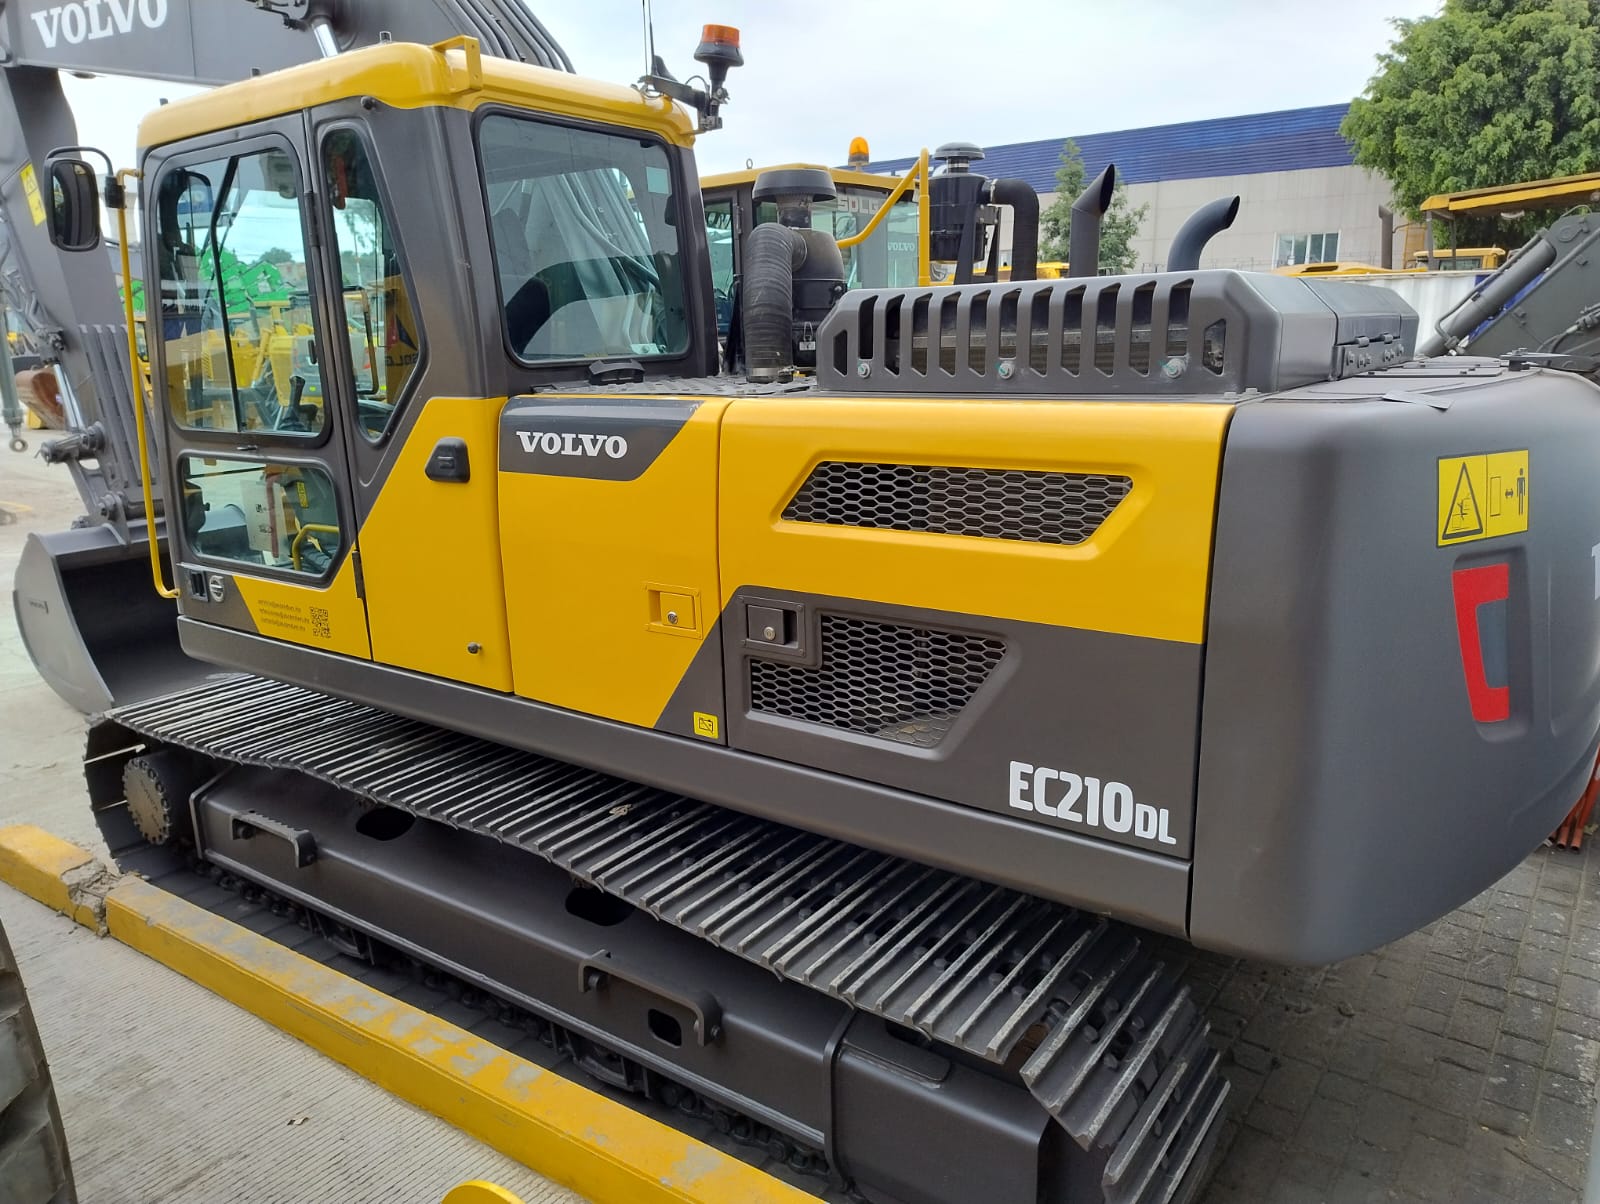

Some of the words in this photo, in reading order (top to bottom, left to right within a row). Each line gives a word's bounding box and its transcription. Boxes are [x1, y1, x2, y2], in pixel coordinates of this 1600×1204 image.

[30, 0, 168, 48] VOLVO
[887, 242, 915, 251] VOLVO
[516, 431, 628, 458] VOLVO
[1009, 760, 1177, 845] EC210DL
